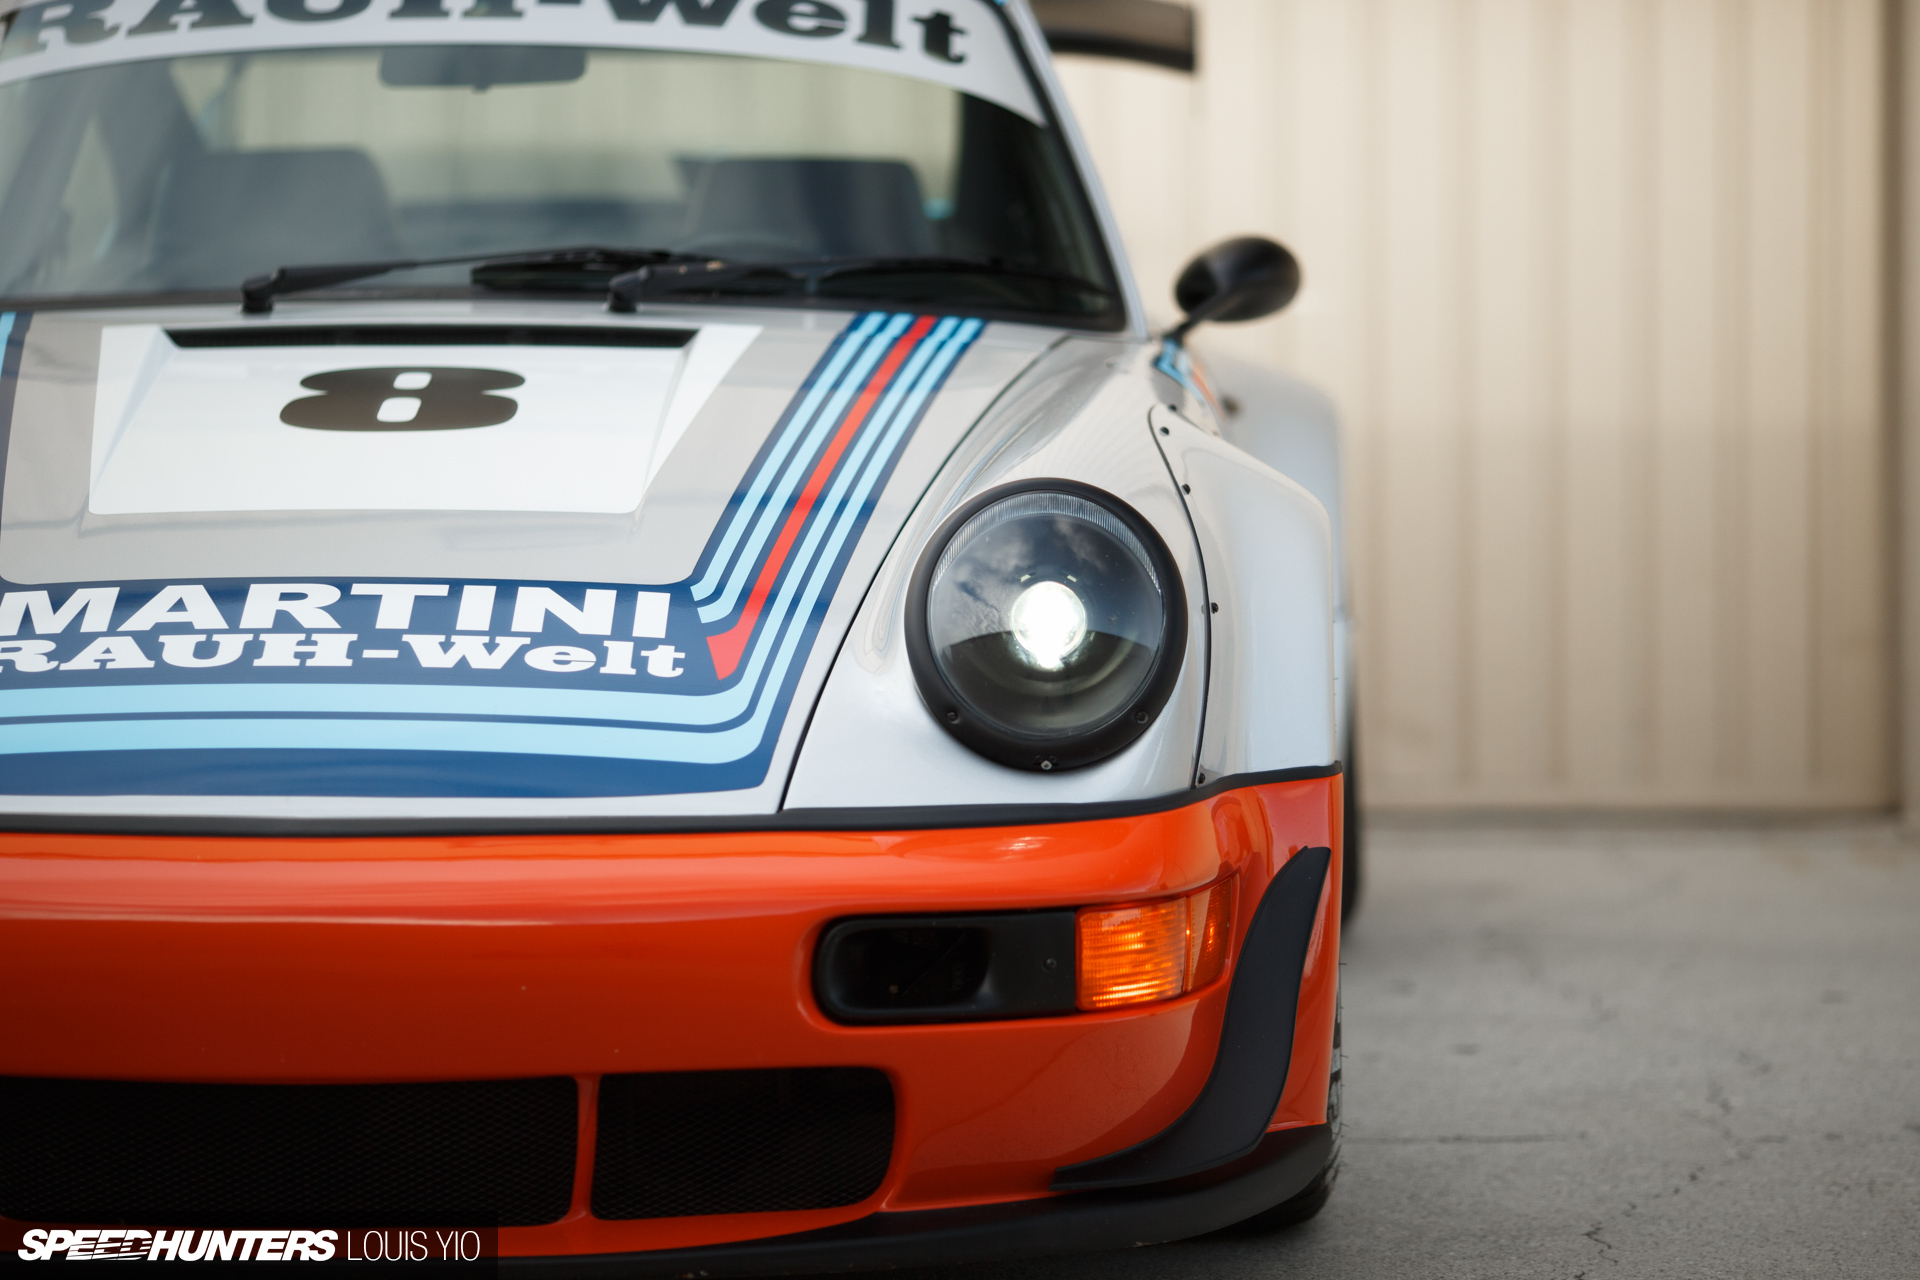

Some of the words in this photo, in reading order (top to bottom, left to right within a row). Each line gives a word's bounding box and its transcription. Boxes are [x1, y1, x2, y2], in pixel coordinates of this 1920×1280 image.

[279, 366, 526, 432] 8
[0, 583, 671, 639] MARTINI
[0, 633, 686, 678] RAUH-Welt
